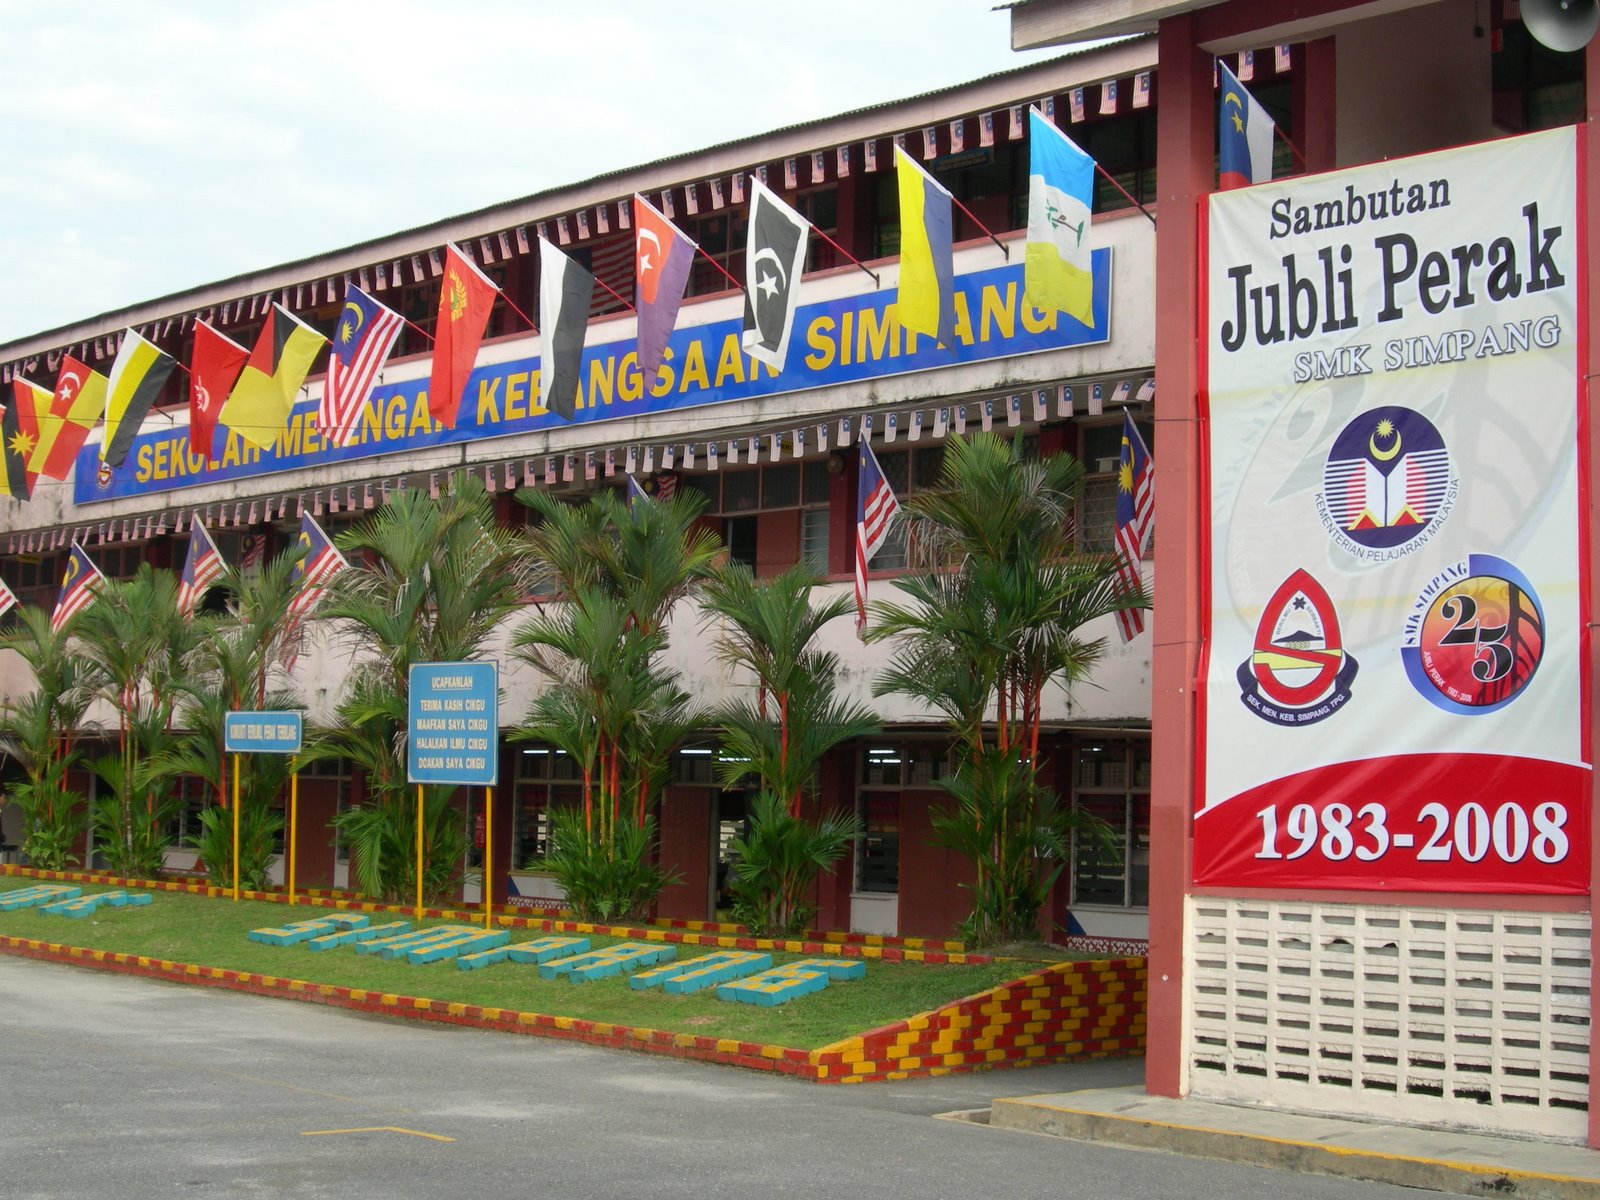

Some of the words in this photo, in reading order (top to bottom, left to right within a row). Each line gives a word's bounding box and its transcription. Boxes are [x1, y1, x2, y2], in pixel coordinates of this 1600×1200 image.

[1269, 177, 1450, 239] Sambutan
[1221, 243, 1358, 352] Jubli
[1375, 201, 1565, 323] Perak
[1293, 344, 1372, 382] SMK
[1385, 315, 1561, 371] SIMPANG
[275, 390, 456, 459] MENGA
[1315, 492, 1364, 559] KEMENTERIAN
[1366, 535, 1429, 562] PELAJARAN
[1428, 477, 1460, 537] MALAYSIA
[1404, 613, 1421, 645] SMK
[1415, 561, 1468, 611] SIMPANG
[1438, 594, 1514, 682] 25
[420, 699, 442, 711] TERIMA
[444, 699, 463, 711] KASIH
[465, 698, 486, 711] CIKGU
[431, 675, 473, 689] UCAPKANLAH
[416, 718, 446, 731] MAAFKAN
[448, 719, 466, 731] SAYA
[467, 719, 488, 731] CIKGU
[416, 737, 448, 750] HALALKAN
[450, 738, 466, 750] ILMU
[467, 738, 488, 750] CIKGU
[1261, 705, 1279, 719] MEN.
[1279, 712, 1297, 722] KEB.
[418, 757, 444, 769] DOAKAN
[446, 757, 464, 769] SAYA
[465, 757, 486, 769] CIKGU
[1254, 801, 1570, 863] 1983-2008
